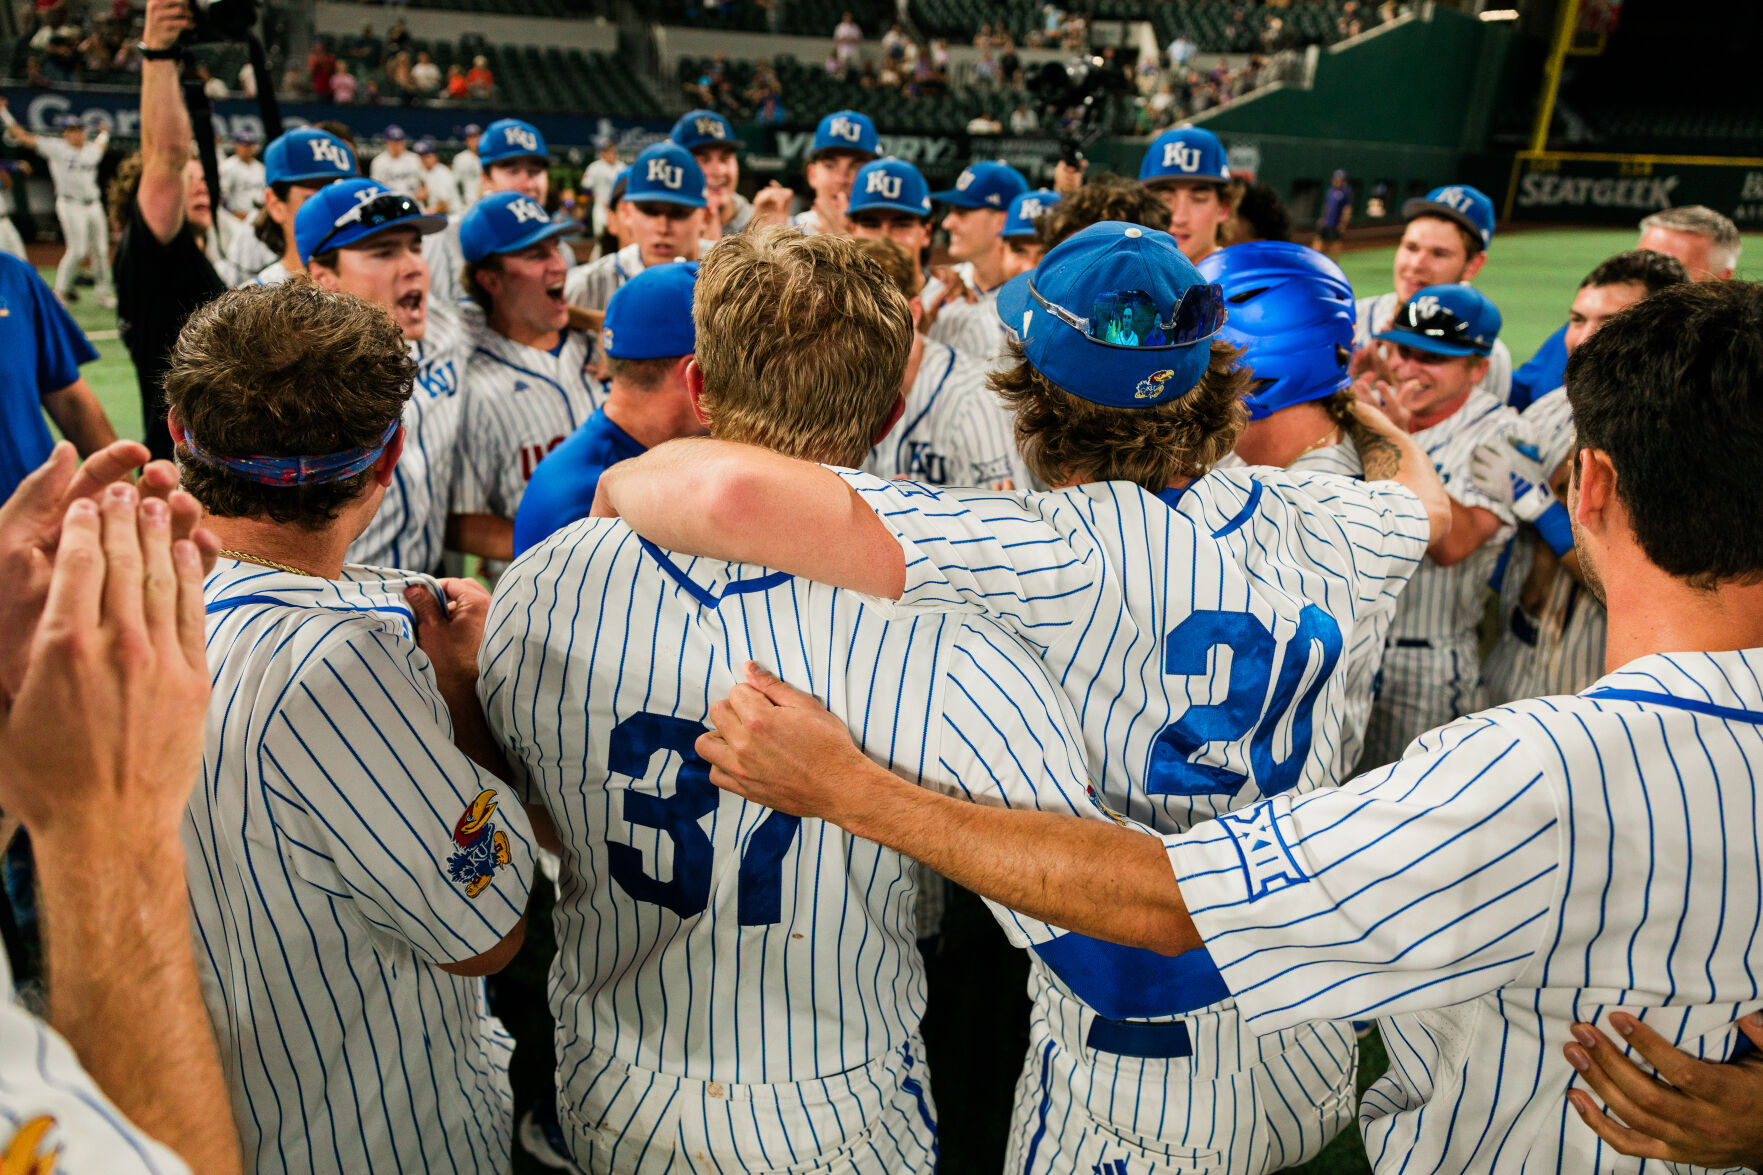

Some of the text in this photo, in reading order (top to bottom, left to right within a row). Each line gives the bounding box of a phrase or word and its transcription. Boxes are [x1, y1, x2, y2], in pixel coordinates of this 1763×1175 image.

[503, 126, 538, 151] KU
[829, 116, 861, 142] KU
[308, 138, 350, 171] KU
[1161, 141, 1202, 172] KU
[646, 158, 683, 189] KU
[865, 169, 903, 199] KU
[1517, 171, 1680, 210] SEATGEEK
[506, 198, 551, 223] KU
[416, 359, 458, 398] KU
[909, 441, 947, 485] KU
[1145, 602, 1344, 798] 20
